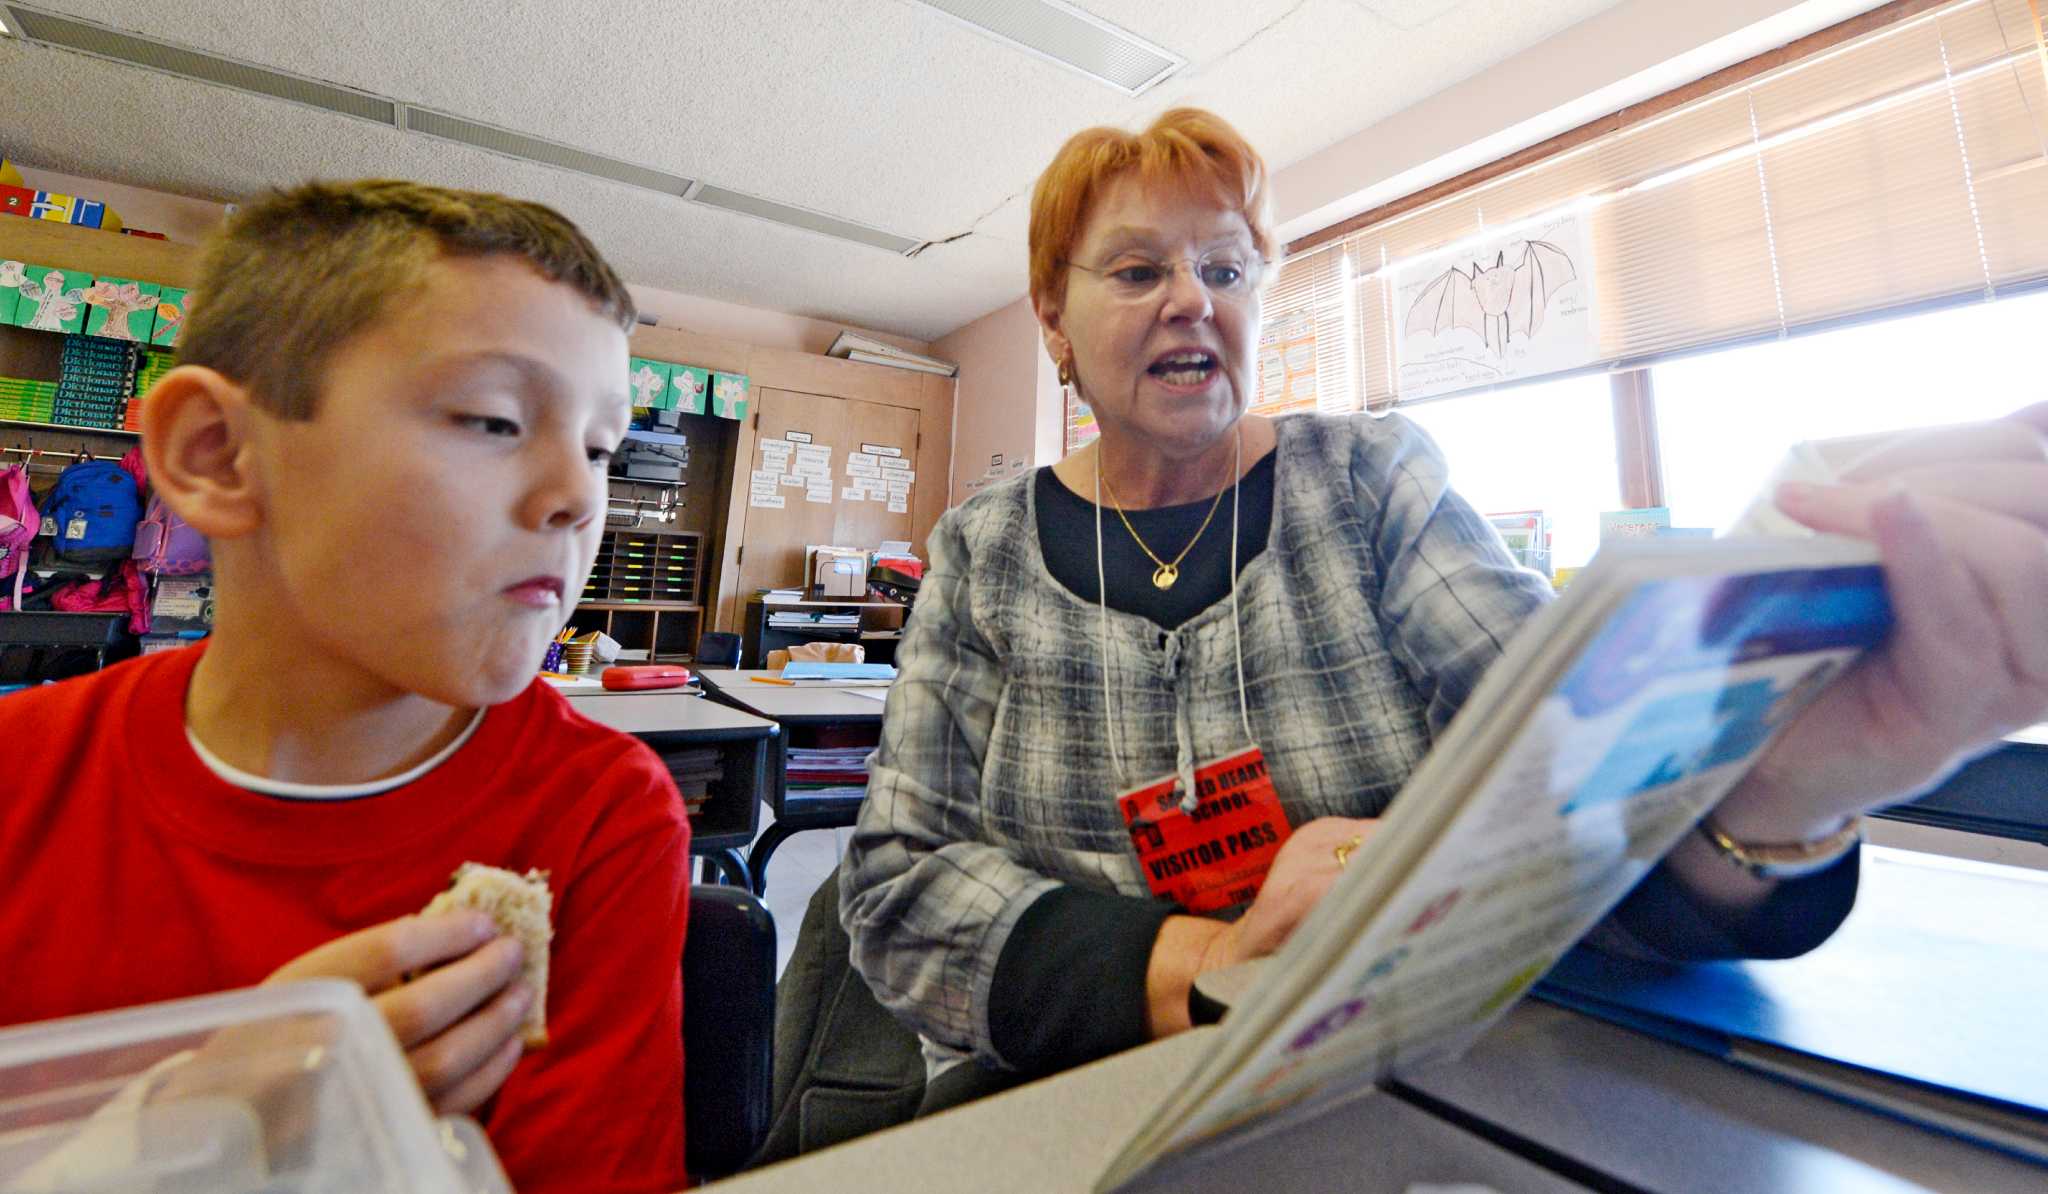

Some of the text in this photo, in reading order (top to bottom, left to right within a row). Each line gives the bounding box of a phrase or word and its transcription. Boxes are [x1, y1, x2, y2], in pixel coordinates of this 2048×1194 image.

[1217, 760, 1266, 789] HEART
[1150, 840, 1226, 880] VISITOR
[1226, 822, 1278, 856] PASS
